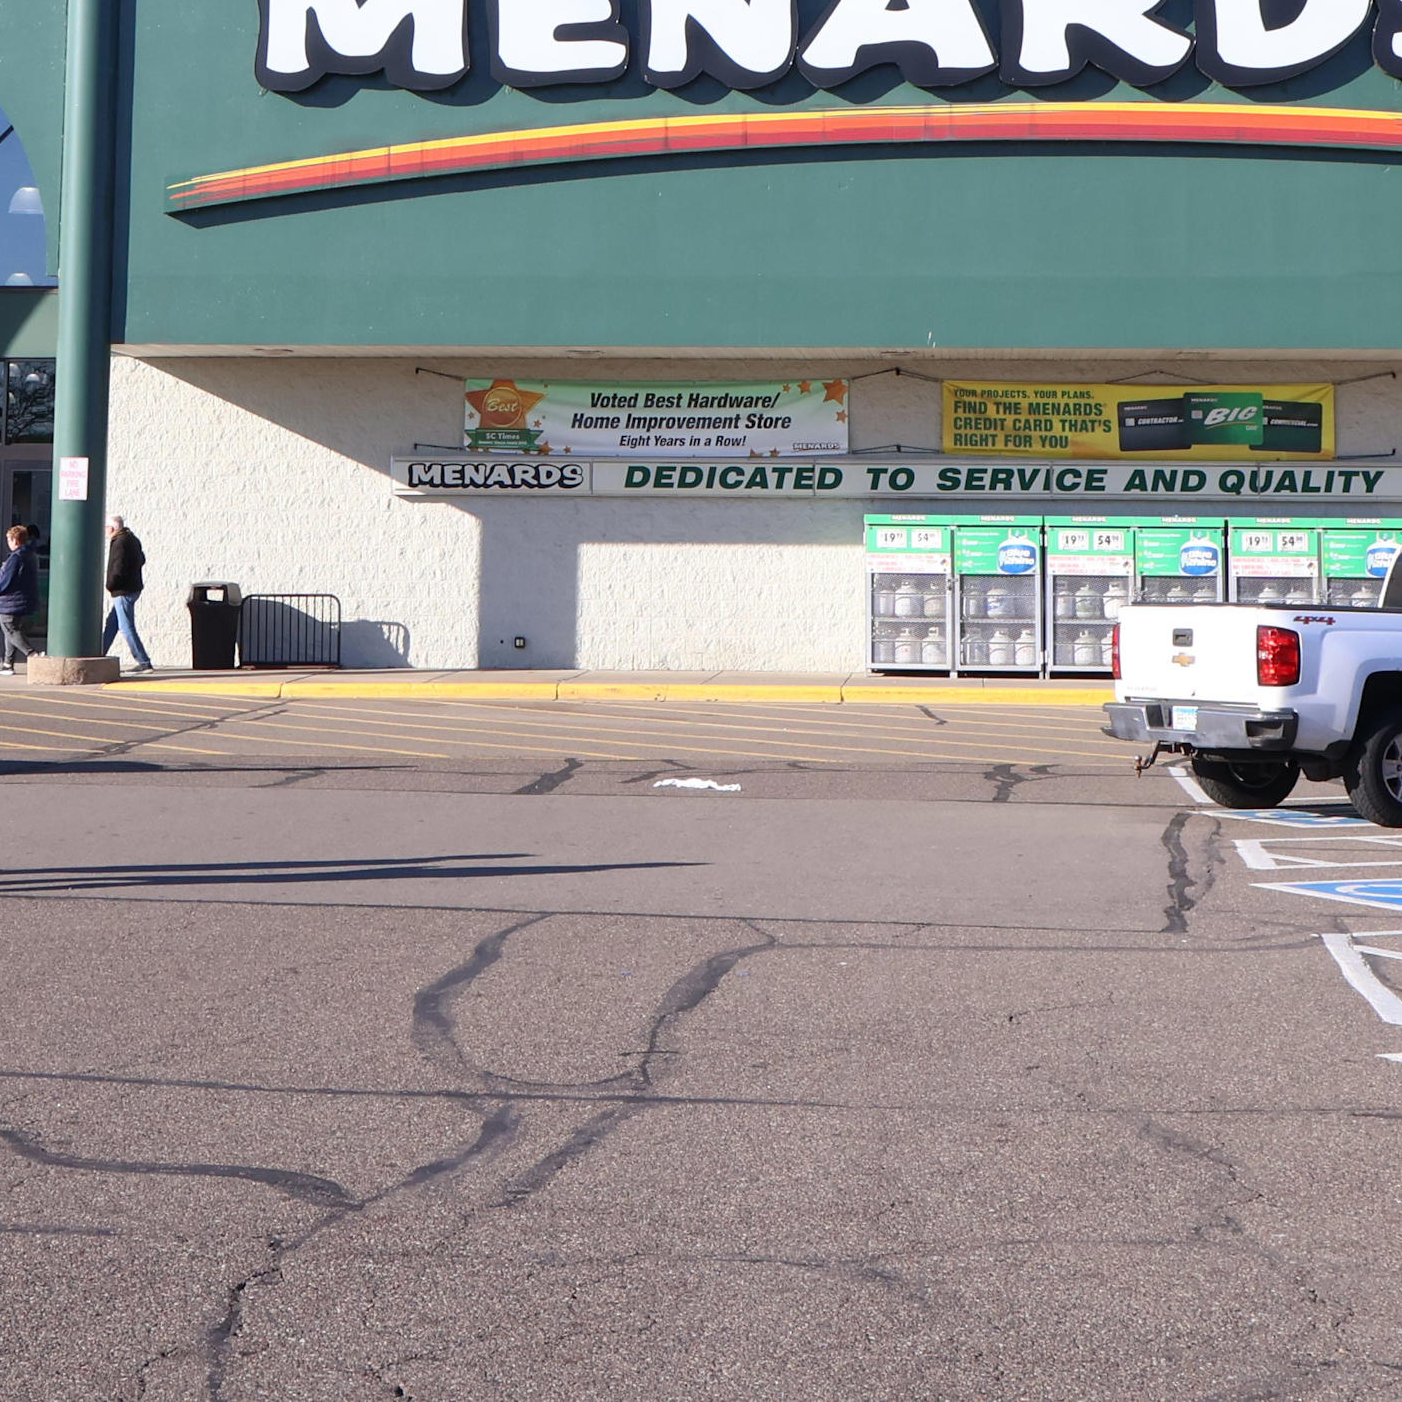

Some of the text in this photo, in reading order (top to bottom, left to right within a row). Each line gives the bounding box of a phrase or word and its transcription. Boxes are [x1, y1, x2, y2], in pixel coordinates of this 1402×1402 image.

[590, 392, 781, 409] Voted Best Hardware/
[953, 389, 1095, 399] YOUR PROJECTS. YOUR PLANS.
[953, 400, 988, 414] FIND
[993, 401, 1022, 415] THE
[1204, 406, 1258, 425] BIG
[571, 413, 792, 433] Home Improvement Store
[953, 416, 1112, 433] CREDIT CARD THAT'S
[498, 432, 520, 440] Times
[619, 435, 747, 448] Eight Years in a Row!
[953, 433, 1069, 448] RIGHT FOR YOU
[792, 442, 840, 452] MENARDS
[408, 462, 584, 489] MENARDS
[624, 465, 1386, 495] DEDICATED TO SERVICE AND QUALITY
